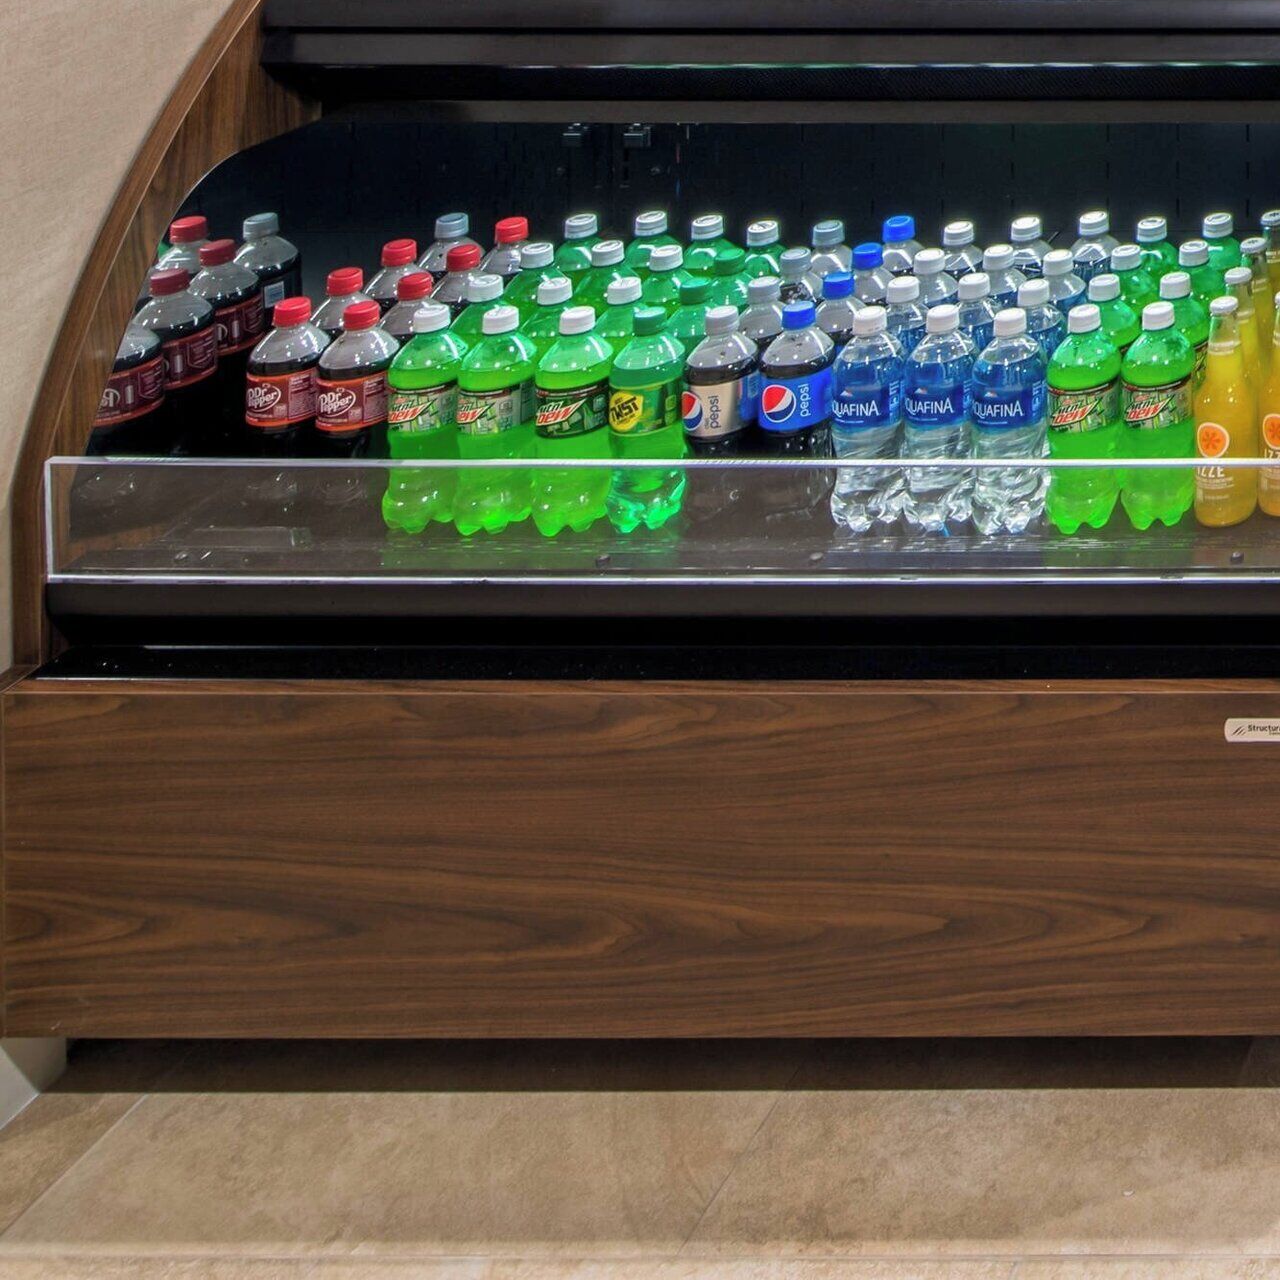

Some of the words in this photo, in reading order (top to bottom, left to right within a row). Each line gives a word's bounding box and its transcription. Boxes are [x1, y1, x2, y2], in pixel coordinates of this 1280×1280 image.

[800, 383, 811, 417] pepsi
[832, 400, 879, 418] QUAFINA
[905, 398, 954, 417] QUAFINA
[708, 395, 722, 429] pepsi
[974, 401, 1024, 419] QUAFINA
